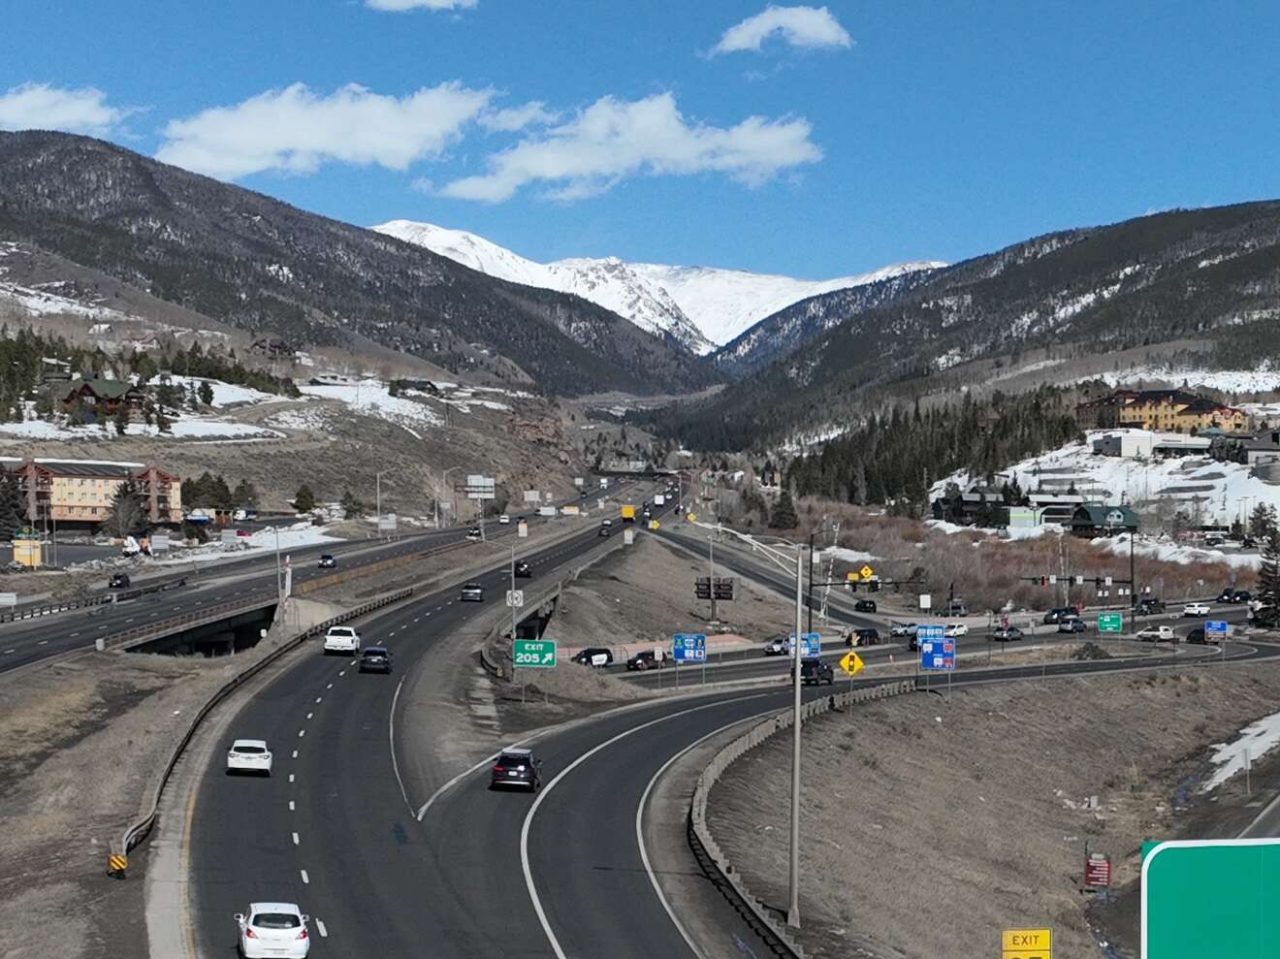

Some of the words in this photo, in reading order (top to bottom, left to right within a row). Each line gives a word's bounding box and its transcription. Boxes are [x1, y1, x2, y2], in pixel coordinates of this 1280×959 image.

[525, 643, 544, 651] EXIT
[516, 652, 540, 663] 205
[1012, 935, 1040, 946] EXIT
